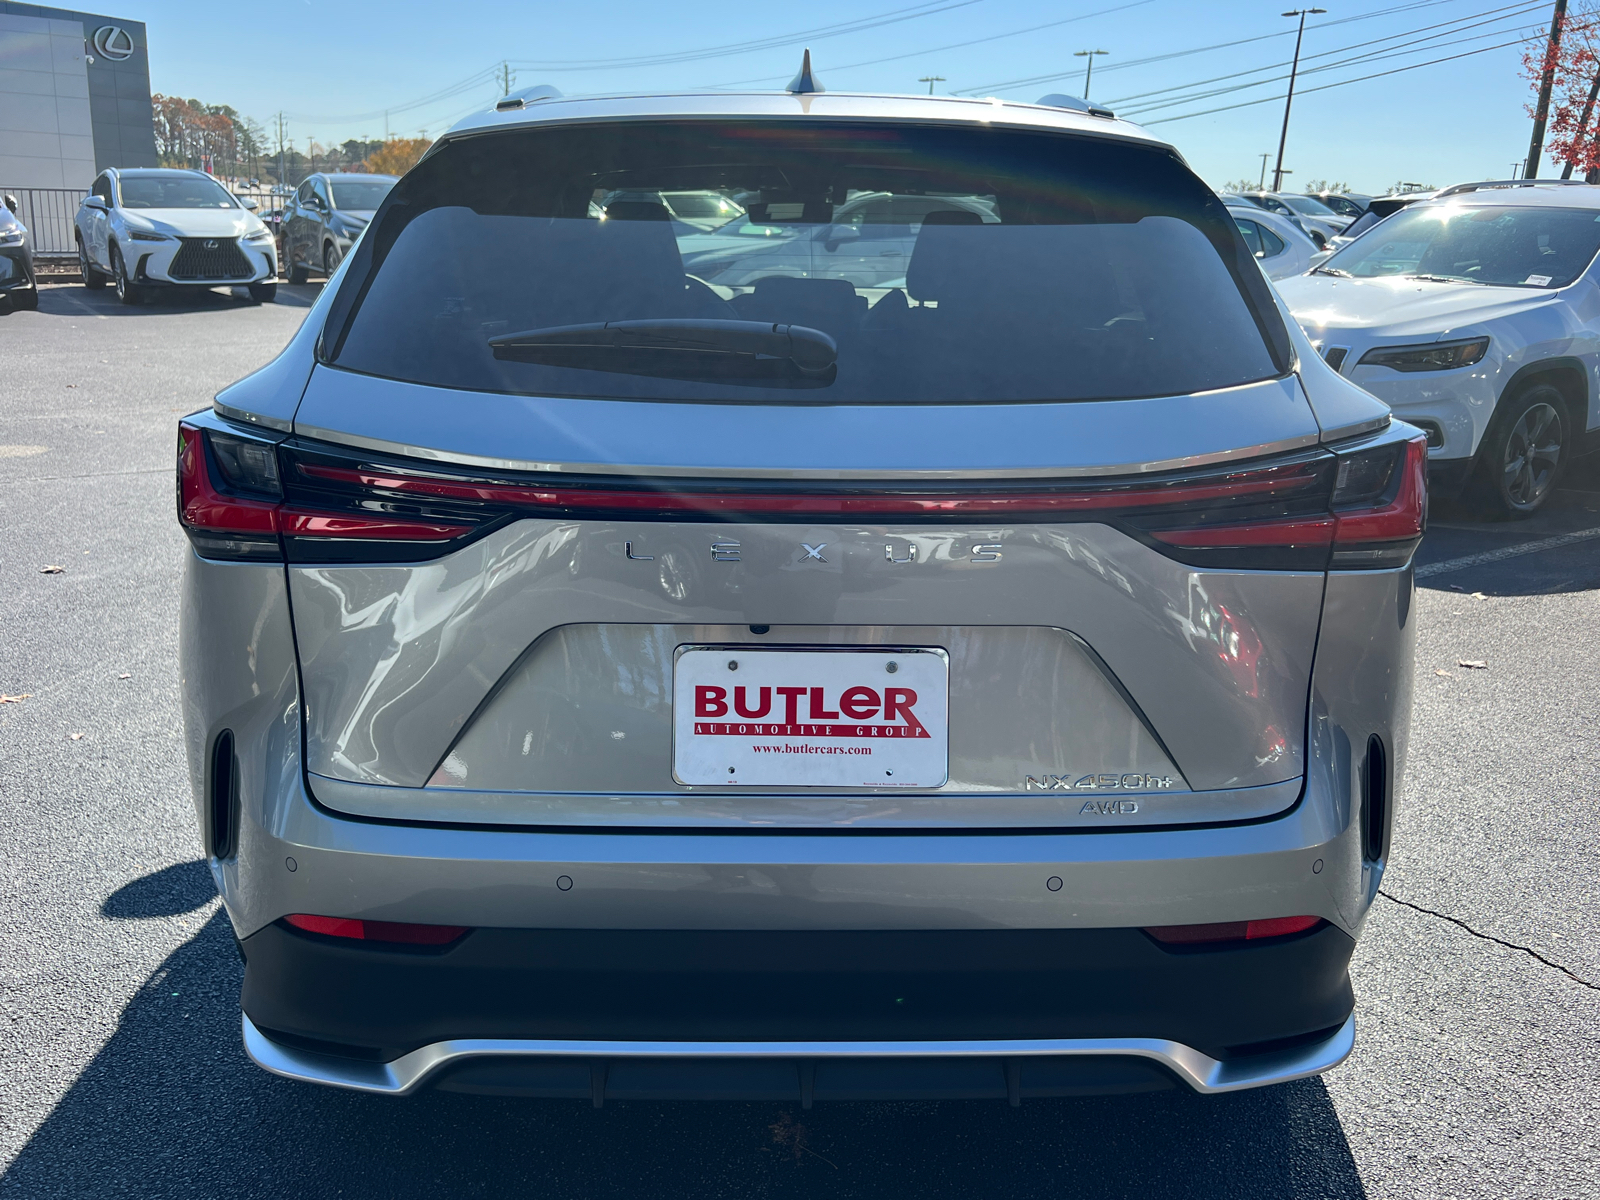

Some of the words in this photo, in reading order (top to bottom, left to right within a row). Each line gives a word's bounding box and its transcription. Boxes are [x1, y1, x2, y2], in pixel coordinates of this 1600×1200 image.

[624, 541, 1003, 564] LEXUS
[695, 724, 832, 736] AUTOMOTIVE
[856, 726, 922, 737] GROUP
[752, 744, 872, 755] www.butlercars.com
[1025, 773, 1173, 790] NX450h+
[1079, 800, 1139, 815] AWD
